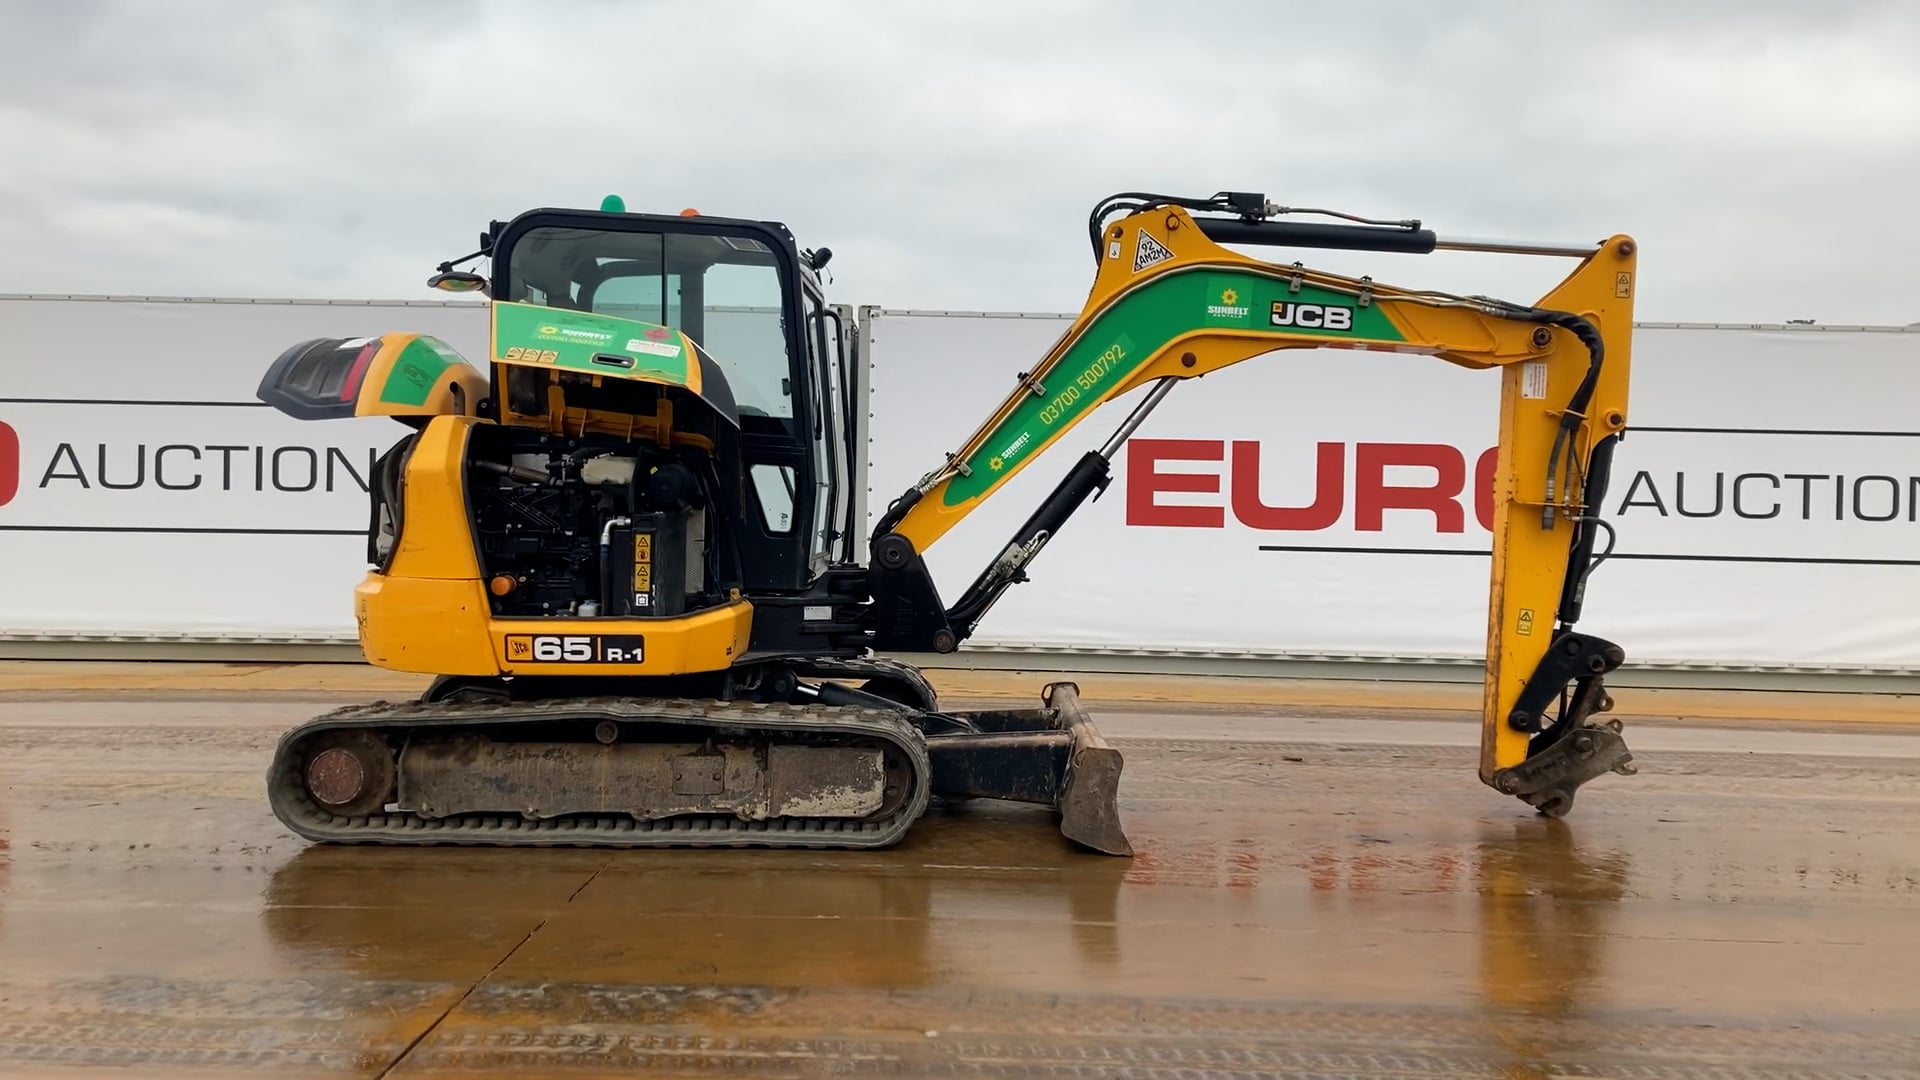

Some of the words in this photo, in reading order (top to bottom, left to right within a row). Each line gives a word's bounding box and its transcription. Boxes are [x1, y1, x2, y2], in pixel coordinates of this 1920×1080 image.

[1141, 241, 1155, 253] 92
[1207, 305, 1249, 316] SUNBELT
[1272, 303, 1352, 330] JCB
[1039, 385, 1080, 425] 03700
[1077, 343, 1126, 390] 500792
[1126, 438, 1500, 534] EUR
[1617, 470, 1920, 522] AUCTIO
[534, 637, 592, 661] 65
[607, 648, 642, 661] R-1
